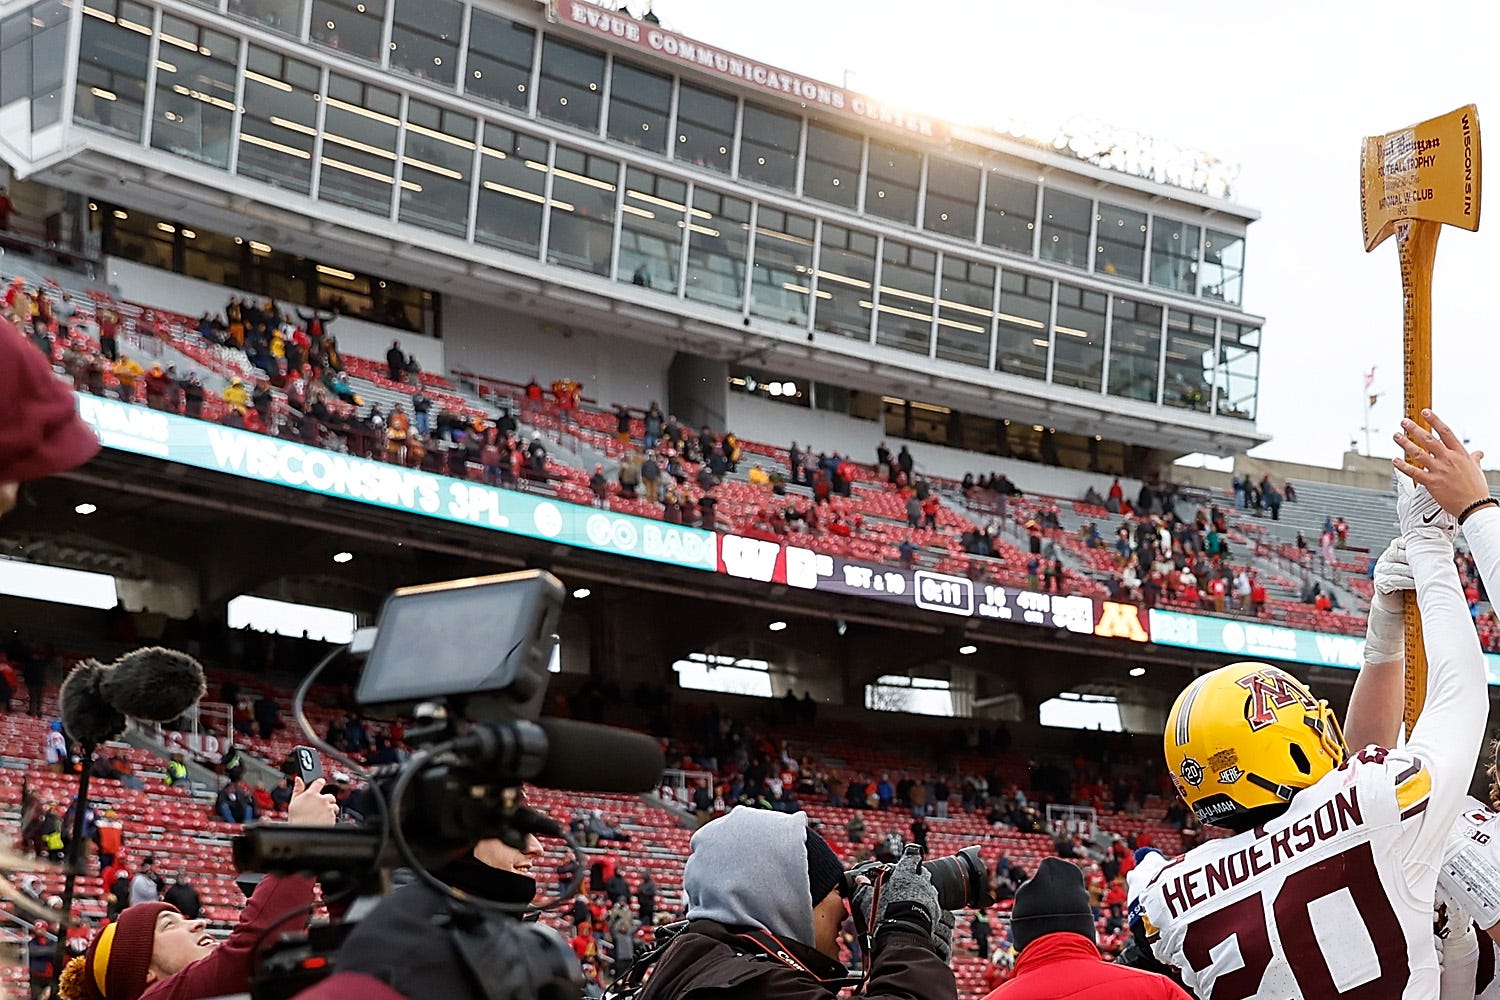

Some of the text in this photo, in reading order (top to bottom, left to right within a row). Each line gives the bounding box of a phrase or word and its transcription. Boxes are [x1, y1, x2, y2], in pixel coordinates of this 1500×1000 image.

[572, 3, 641, 43] EVJUE
[648, 28, 845, 109] COMMUNICATIONS
[1461, 114, 1472, 216] WISCONSIN
[207, 427, 441, 514] WISCONSIN'S
[448, 482, 509, 528] 3PL
[586, 513, 638, 551] GO
[1184, 765, 1199, 780] 20
[1162, 785, 1364, 920] HENDERSON
